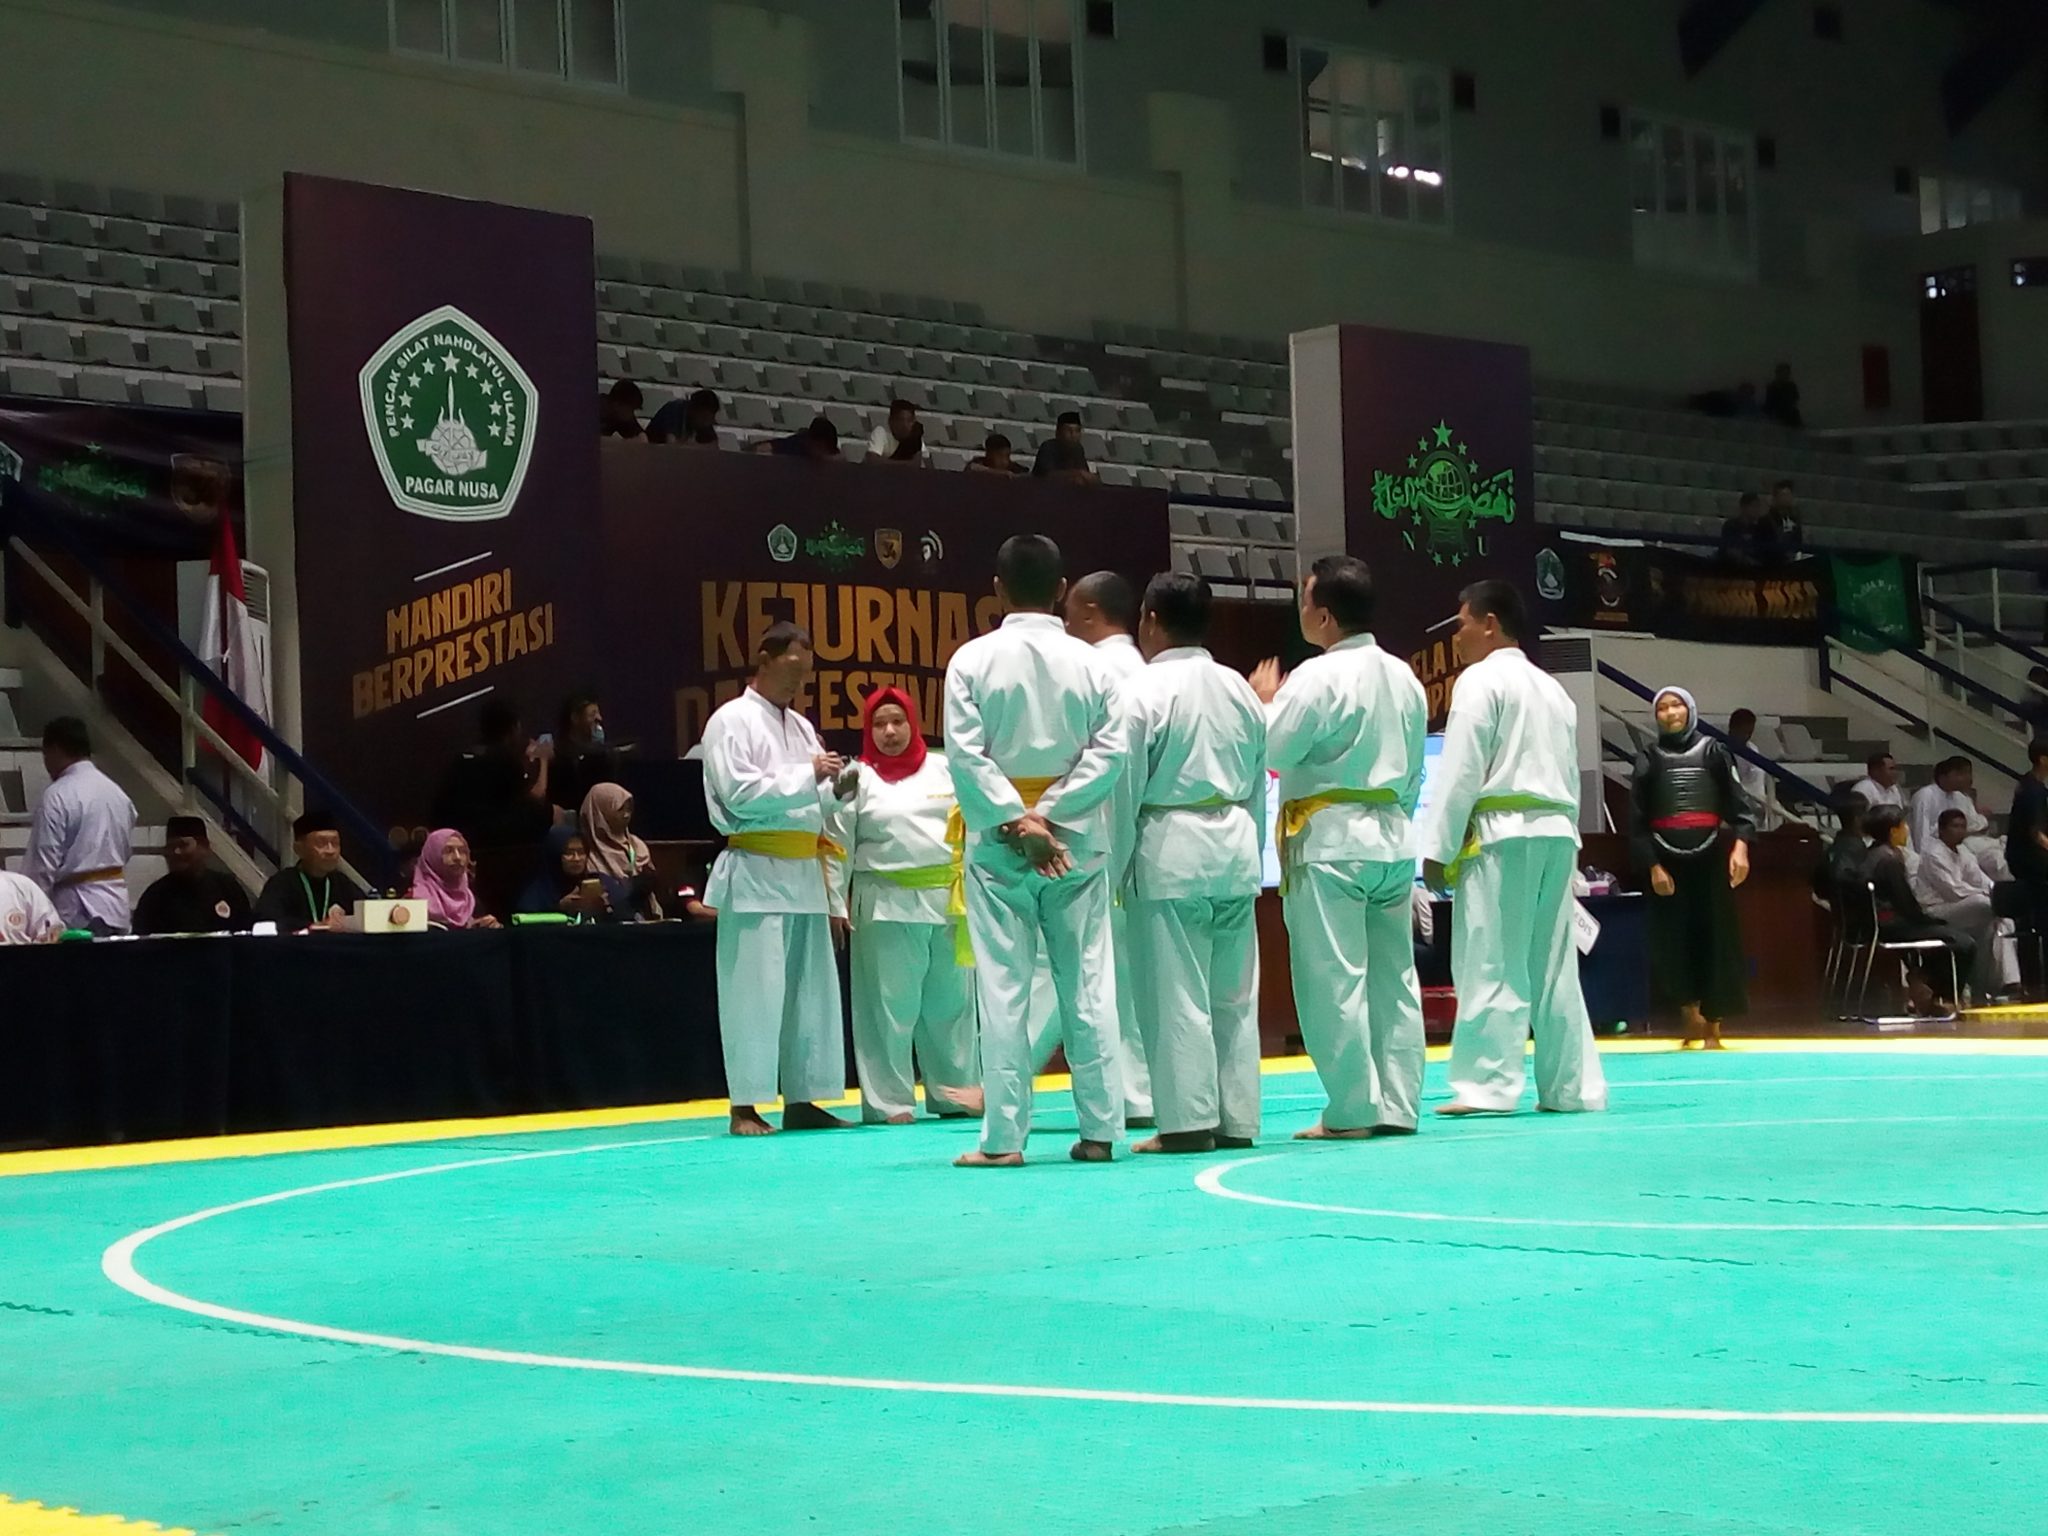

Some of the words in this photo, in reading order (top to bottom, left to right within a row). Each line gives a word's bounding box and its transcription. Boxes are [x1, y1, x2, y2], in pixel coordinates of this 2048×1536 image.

[385, 369, 401, 438] PENCAK
[397, 336, 430, 369] SILAT
[433, 333, 507, 387] NAHDLATUL
[502, 390, 516, 446] ULAMA
[405, 476, 455, 496] PAGAR
[458, 477, 499, 499] NUSA
[352, 602, 554, 720] BERPRESTASI
[387, 566, 512, 655] MANDIRI
